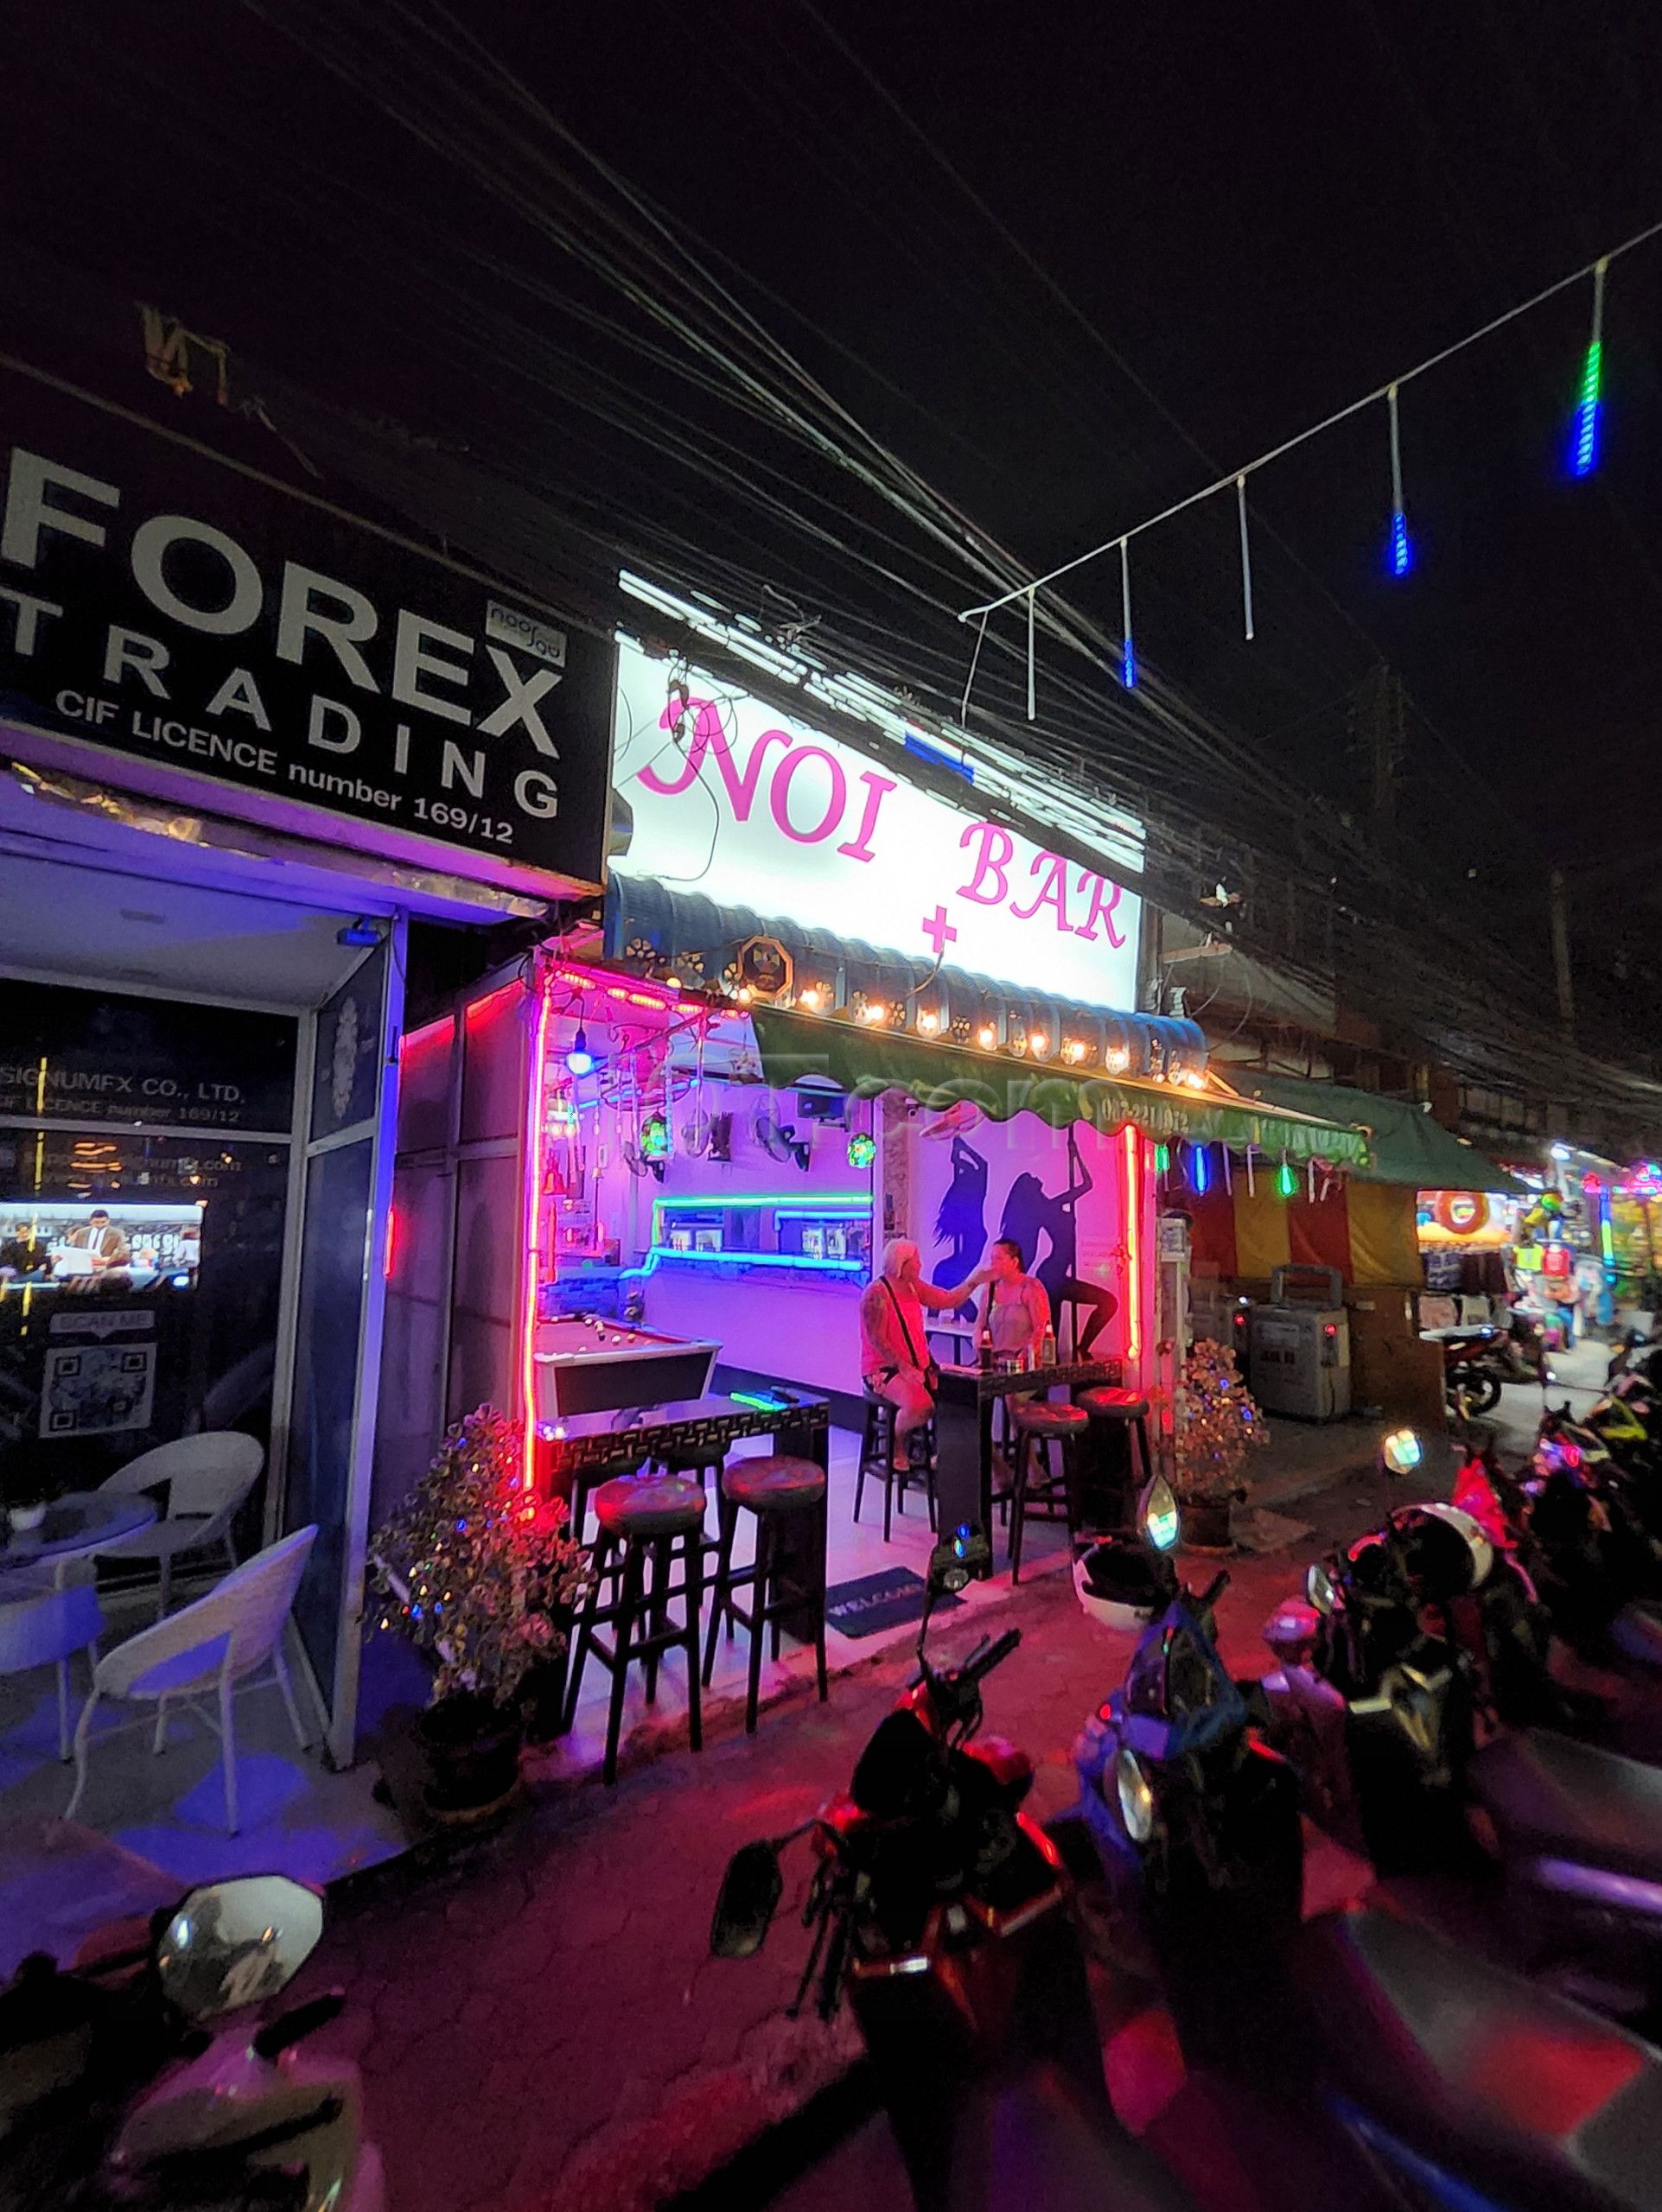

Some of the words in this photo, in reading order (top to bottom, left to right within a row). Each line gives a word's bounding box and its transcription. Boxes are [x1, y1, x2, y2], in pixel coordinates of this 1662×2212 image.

[0, 585, 558, 820] TRADING
[1, 446, 564, 760] FOREX
[55, 690, 119, 725] CIF
[132, 711, 277, 775] LICENCE
[289, 762, 402, 810] number
[413, 797, 513, 844] 169/12
[635, 696, 898, 862] NOI
[956, 821, 1127, 948] BAR
[141, 1077, 189, 1099] CO.,
[198, 1082, 245, 1104] LTD.
